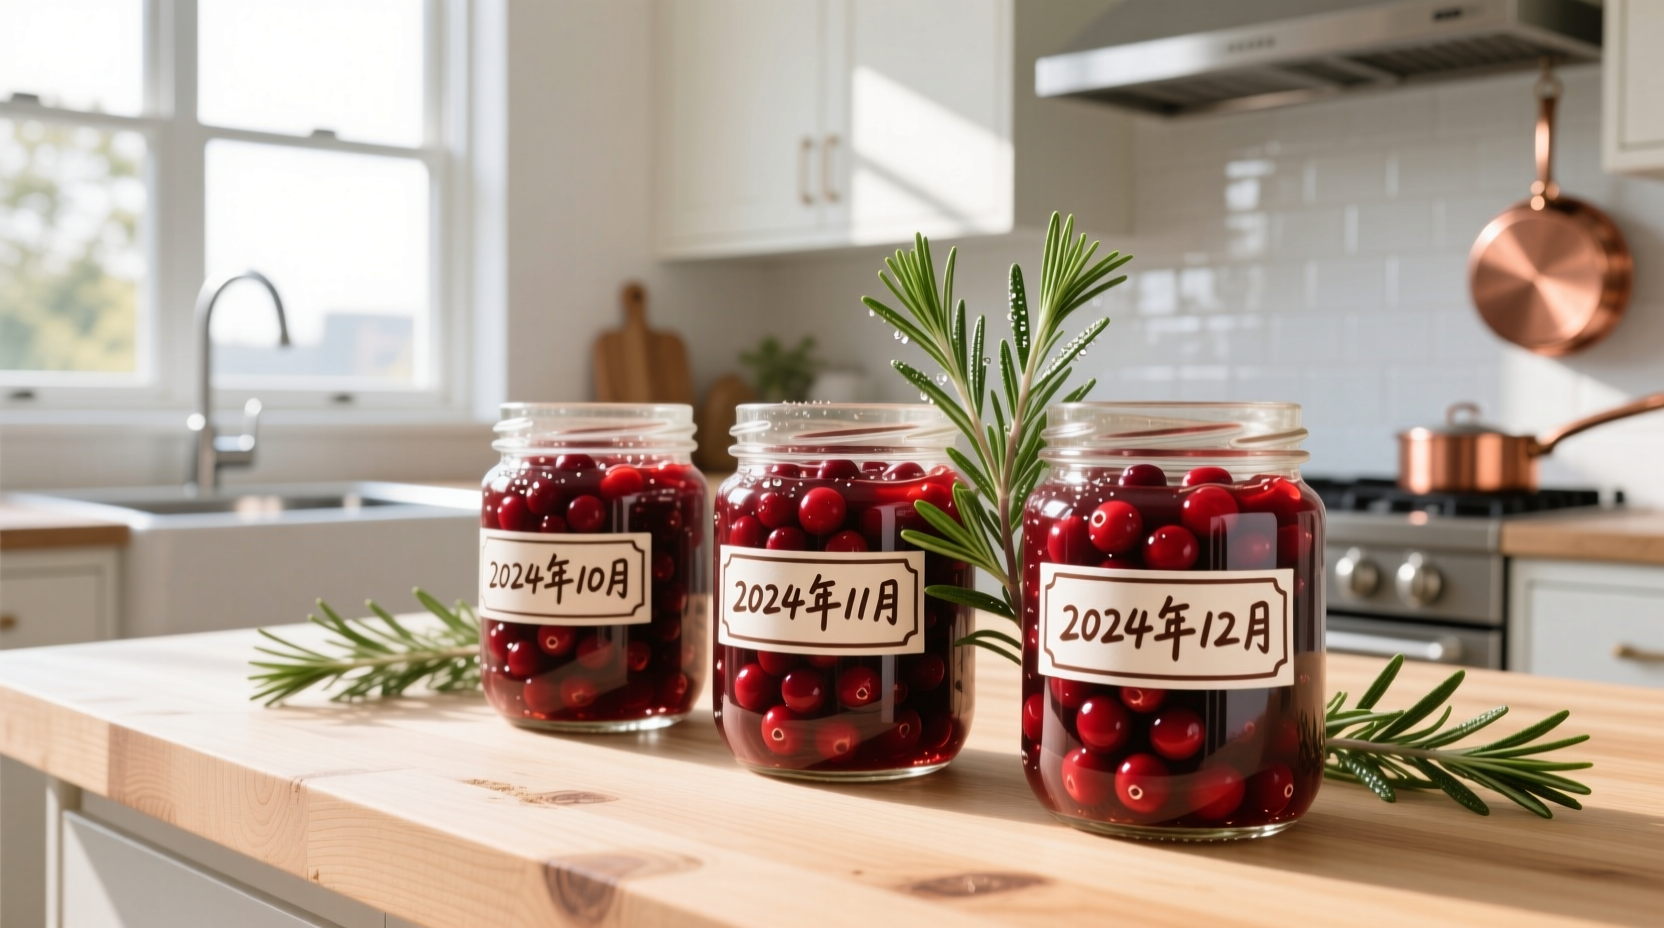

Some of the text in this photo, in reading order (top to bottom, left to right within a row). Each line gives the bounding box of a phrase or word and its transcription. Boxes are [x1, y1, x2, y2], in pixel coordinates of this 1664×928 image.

[489, 553, 629, 606] 2024年10月
[732, 573, 899, 633] 2024年11月
[1059, 594, 1270, 662] 2024年12月
